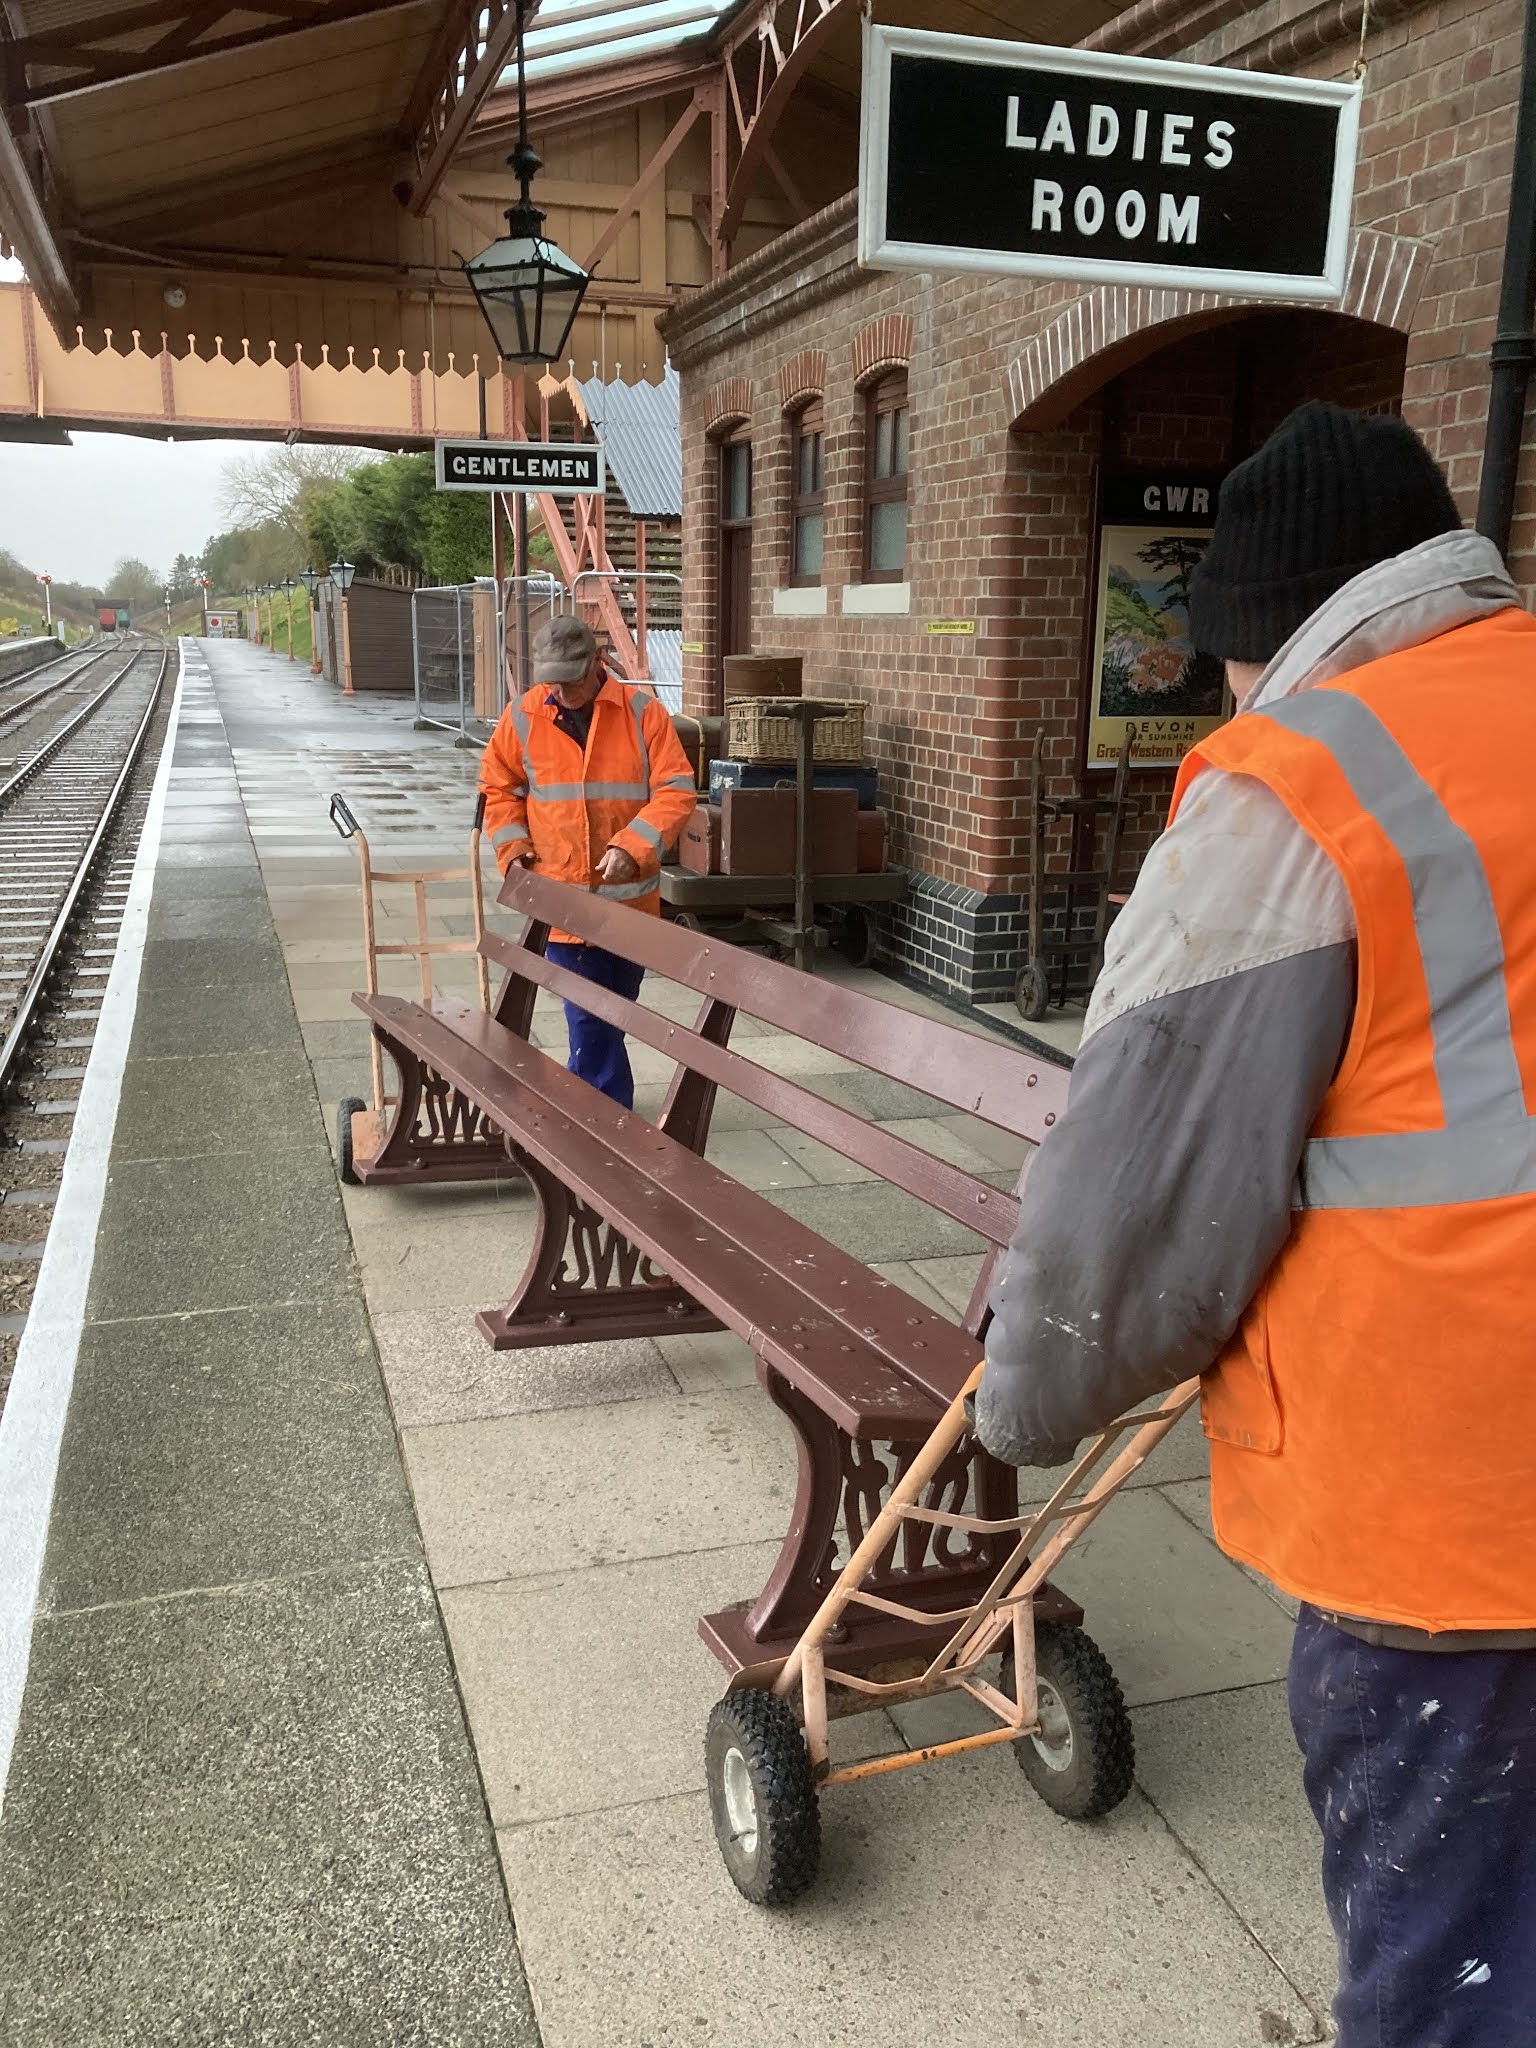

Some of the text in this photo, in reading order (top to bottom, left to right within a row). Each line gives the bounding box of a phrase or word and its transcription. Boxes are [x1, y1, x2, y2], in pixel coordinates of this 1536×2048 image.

[1005, 95, 1236, 169] LADIES
[1031, 178, 1200, 245] ROOM
[452, 456, 590, 479] GENTLEMEN
[1143, 485, 1210, 514] GWR
[1125, 721, 1195, 733] DEVON
[1148, 733, 1194, 741] SUNSHINE
[1096, 743, 1123, 758] Grea
[1130, 743, 1173, 758] Western
